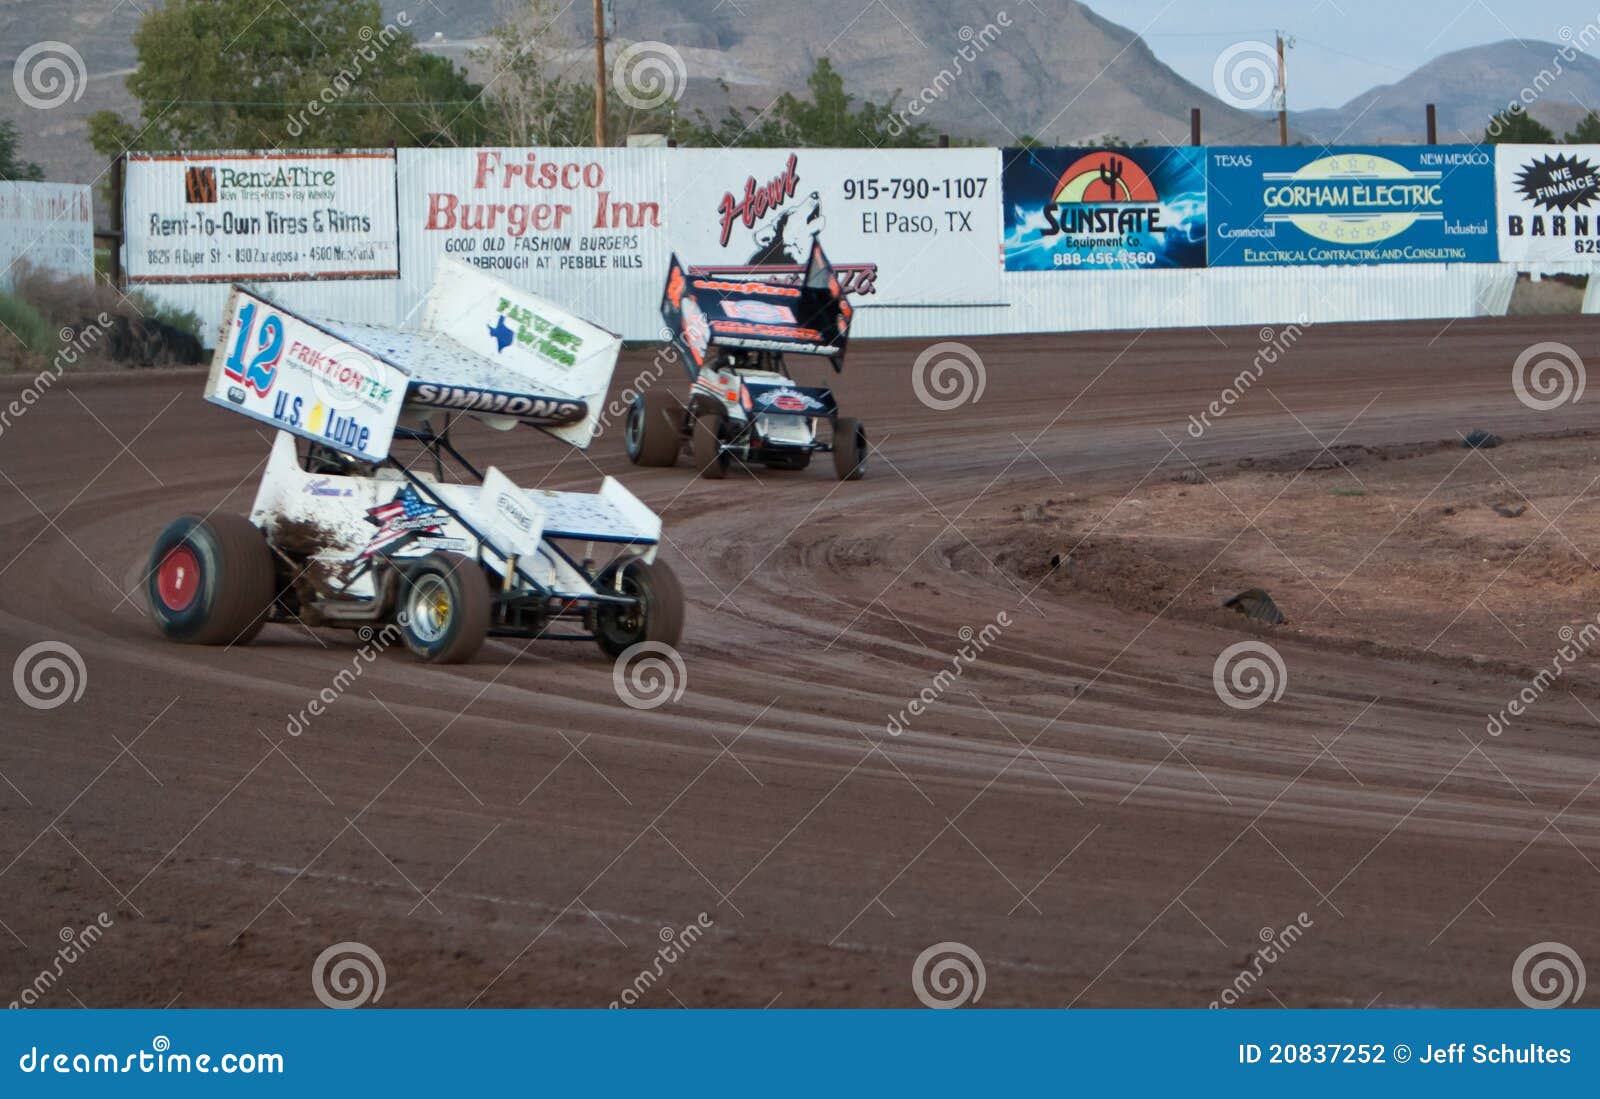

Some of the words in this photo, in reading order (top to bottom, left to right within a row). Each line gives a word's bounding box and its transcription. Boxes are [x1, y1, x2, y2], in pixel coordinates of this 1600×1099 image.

[1214, 155, 1252, 166] TEXAS
[1420, 153, 1442, 165] NEW
[1444, 153, 1489, 165] MEXICO
[472, 151, 604, 190] Frisco
[1549, 167, 1572, 182] WE
[843, 178, 988, 200] 915-790-1107
[1263, 186, 1349, 207] GORHAM
[1352, 185, 1443, 206] ELECTRIC
[1535, 175, 1596, 200] FINANCE
[265, 210, 308, 234] Tires
[312, 209, 324, 233] &
[327, 208, 371, 233] Rims
[423, 192, 572, 237] Burger
[593, 191, 662, 229] Inn
[863, 212, 878, 233] El
[886, 212, 938, 235] Paso,
[945, 211, 972, 232] TX
[1040, 202, 1167, 236] SUNSTATE
[1217, 222, 1276, 239] Commercial
[1444, 219, 1488, 235] Industrial
[1508, 215, 1600, 236] BARN
[445, 237, 476, 252] GOOD
[483, 236, 505, 251] OLD
[514, 236, 571, 252] FASHION
[579, 235, 638, 251] BURGERS
[1066, 236, 1123, 250] Equipment
[536, 256, 551, 268] AT
[560, 256, 607, 269] PEBBLE
[613, 256, 643, 269] HILLS
[1244, 249, 1305, 262] ELECTRICAL
[1308, 247, 1380, 261] CONTRACTING
[1382, 249, 1402, 260] AND
[1403, 246, 1466, 259] CONSULTING
[224, 303, 286, 399] 12
[324, 408, 370, 451] Lube
